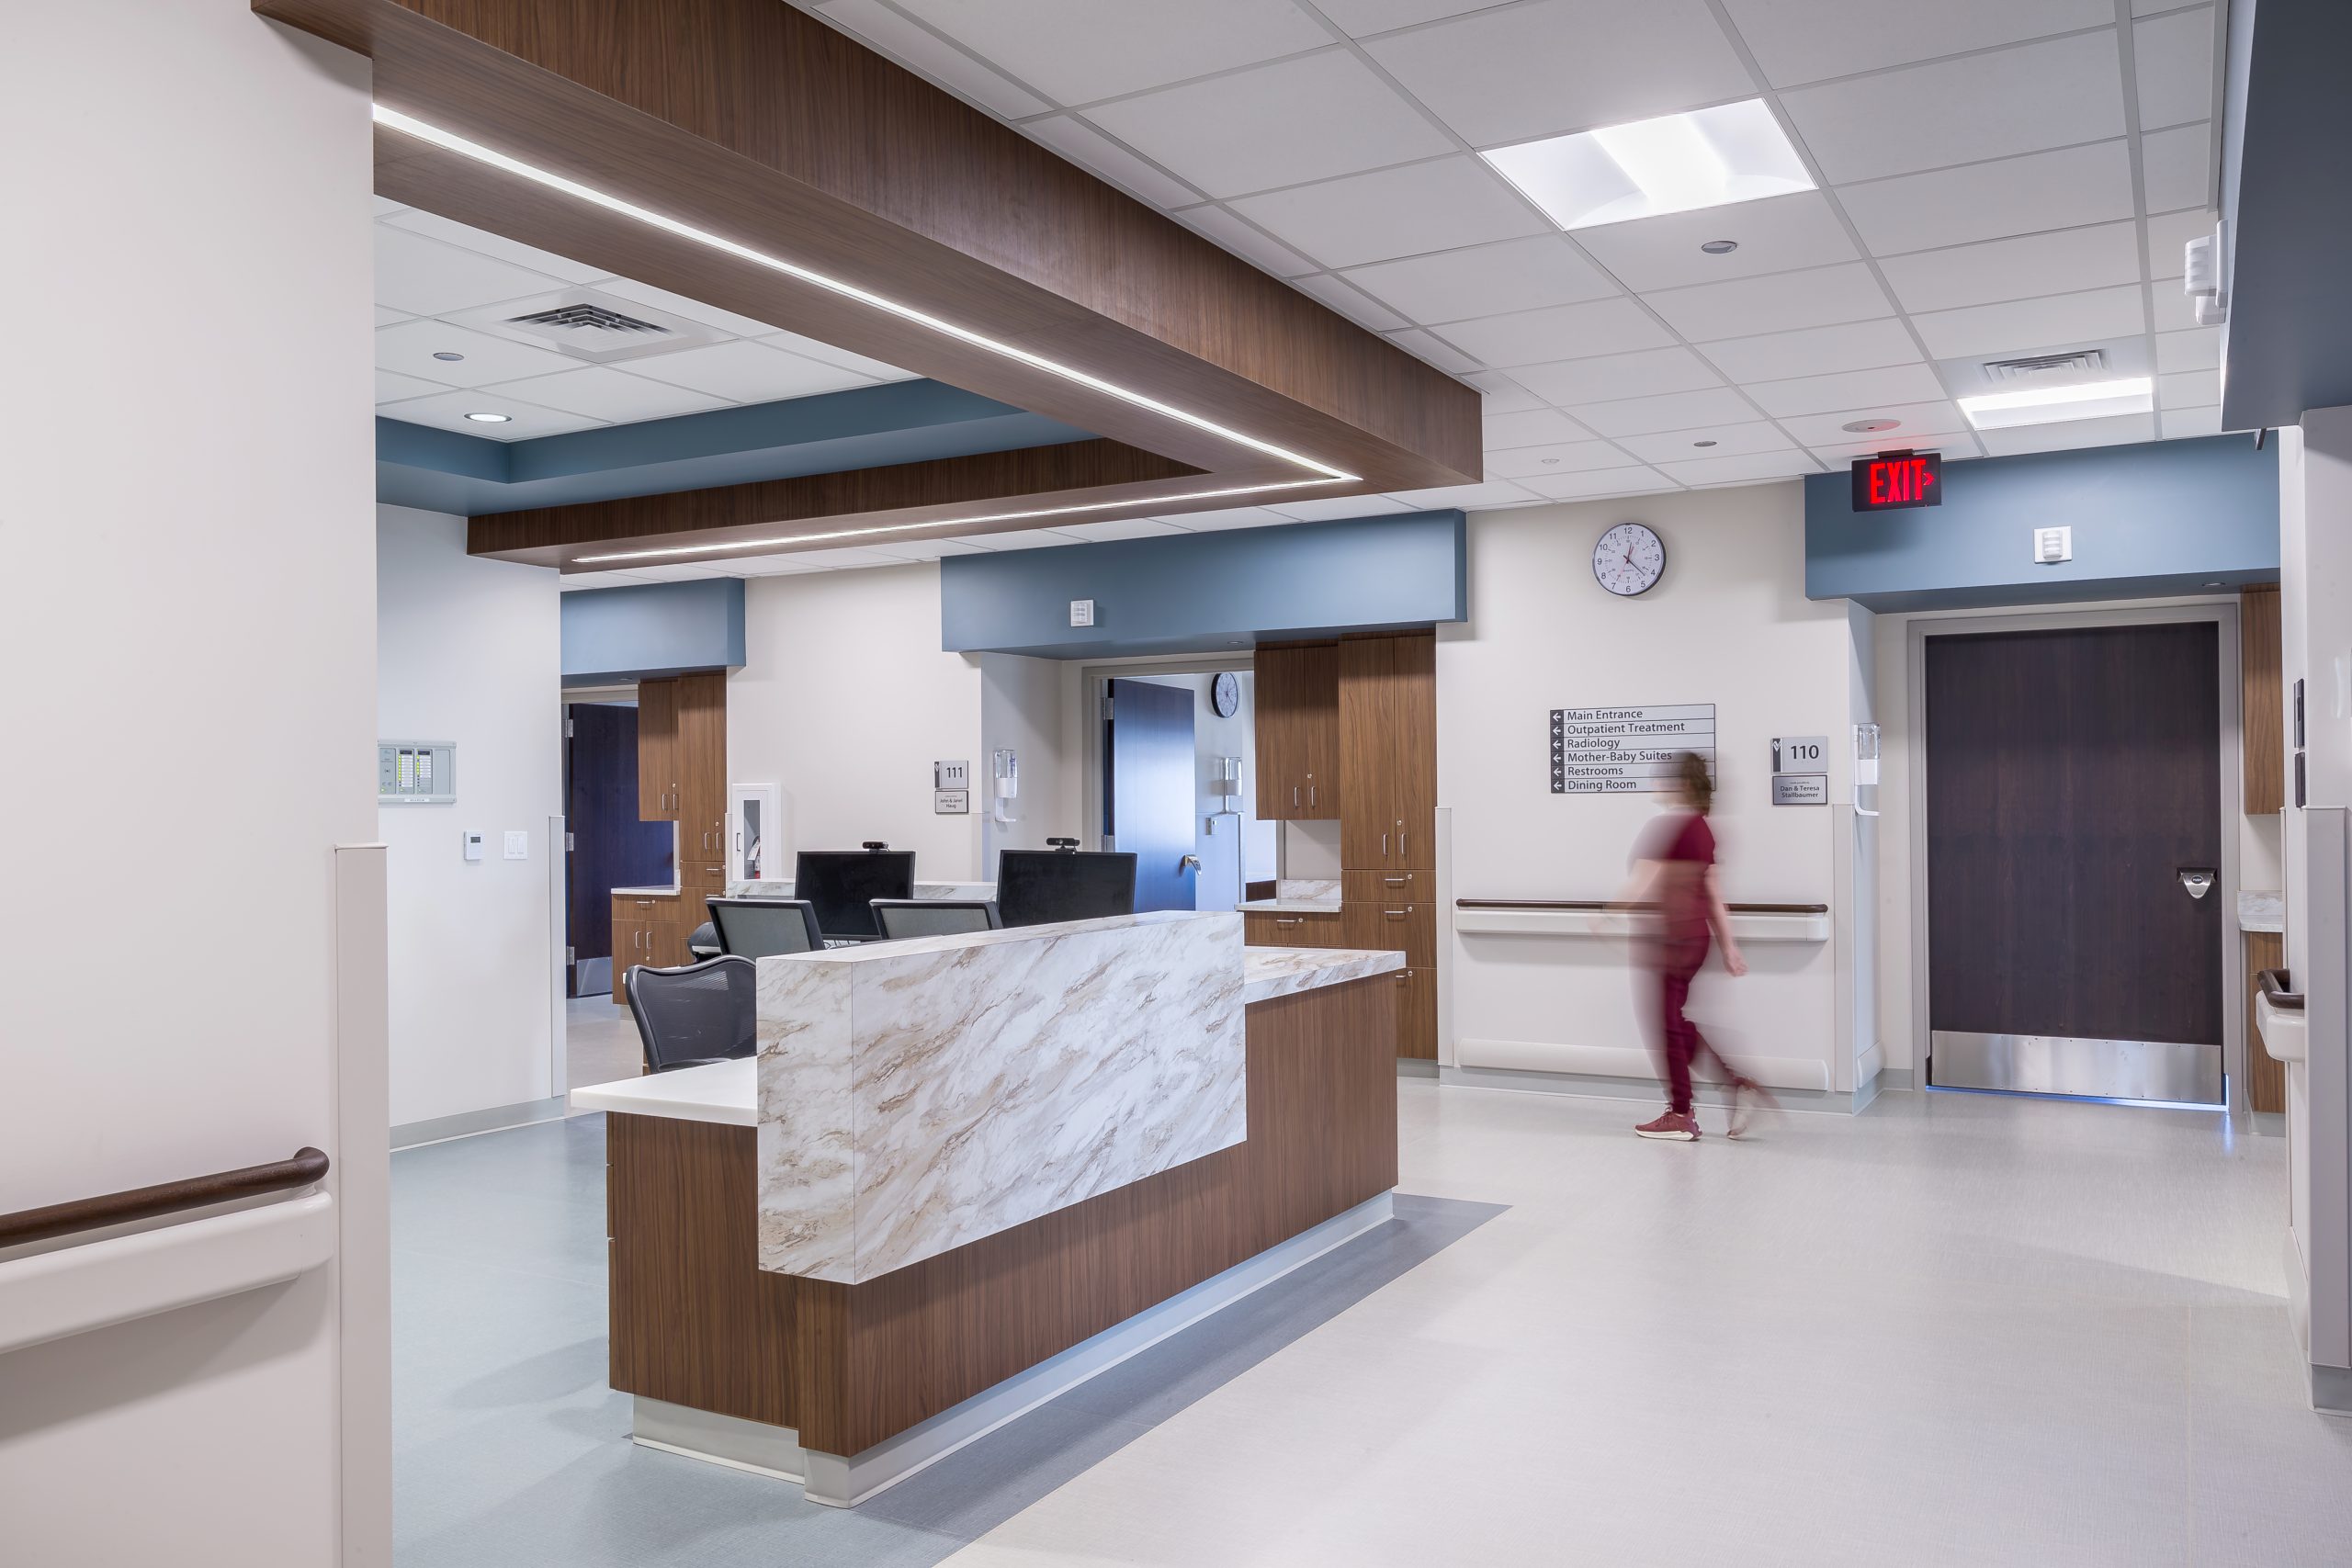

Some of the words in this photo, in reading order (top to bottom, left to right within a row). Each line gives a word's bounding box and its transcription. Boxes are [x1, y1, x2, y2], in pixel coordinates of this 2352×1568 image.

[1870, 458, 1927, 504] EXIT
[1567, 711, 1593, 720] Main
[1596, 710, 1643, 719] Entrance
[1567, 724, 1625, 736] Outpatient
[1628, 723, 1685, 733] Treatment
[1567, 738, 1620, 749] Radiology
[1567, 751, 1636, 763] Mother-Baby
[1639, 750, 1672, 761] Suites
[1791, 745, 1819, 760] 110
[946, 767, 962, 778] 111
[1567, 766, 1623, 775] Restrooms
[1568, 780, 1602, 791] Dining
[1606, 780, 1637, 789] Room
